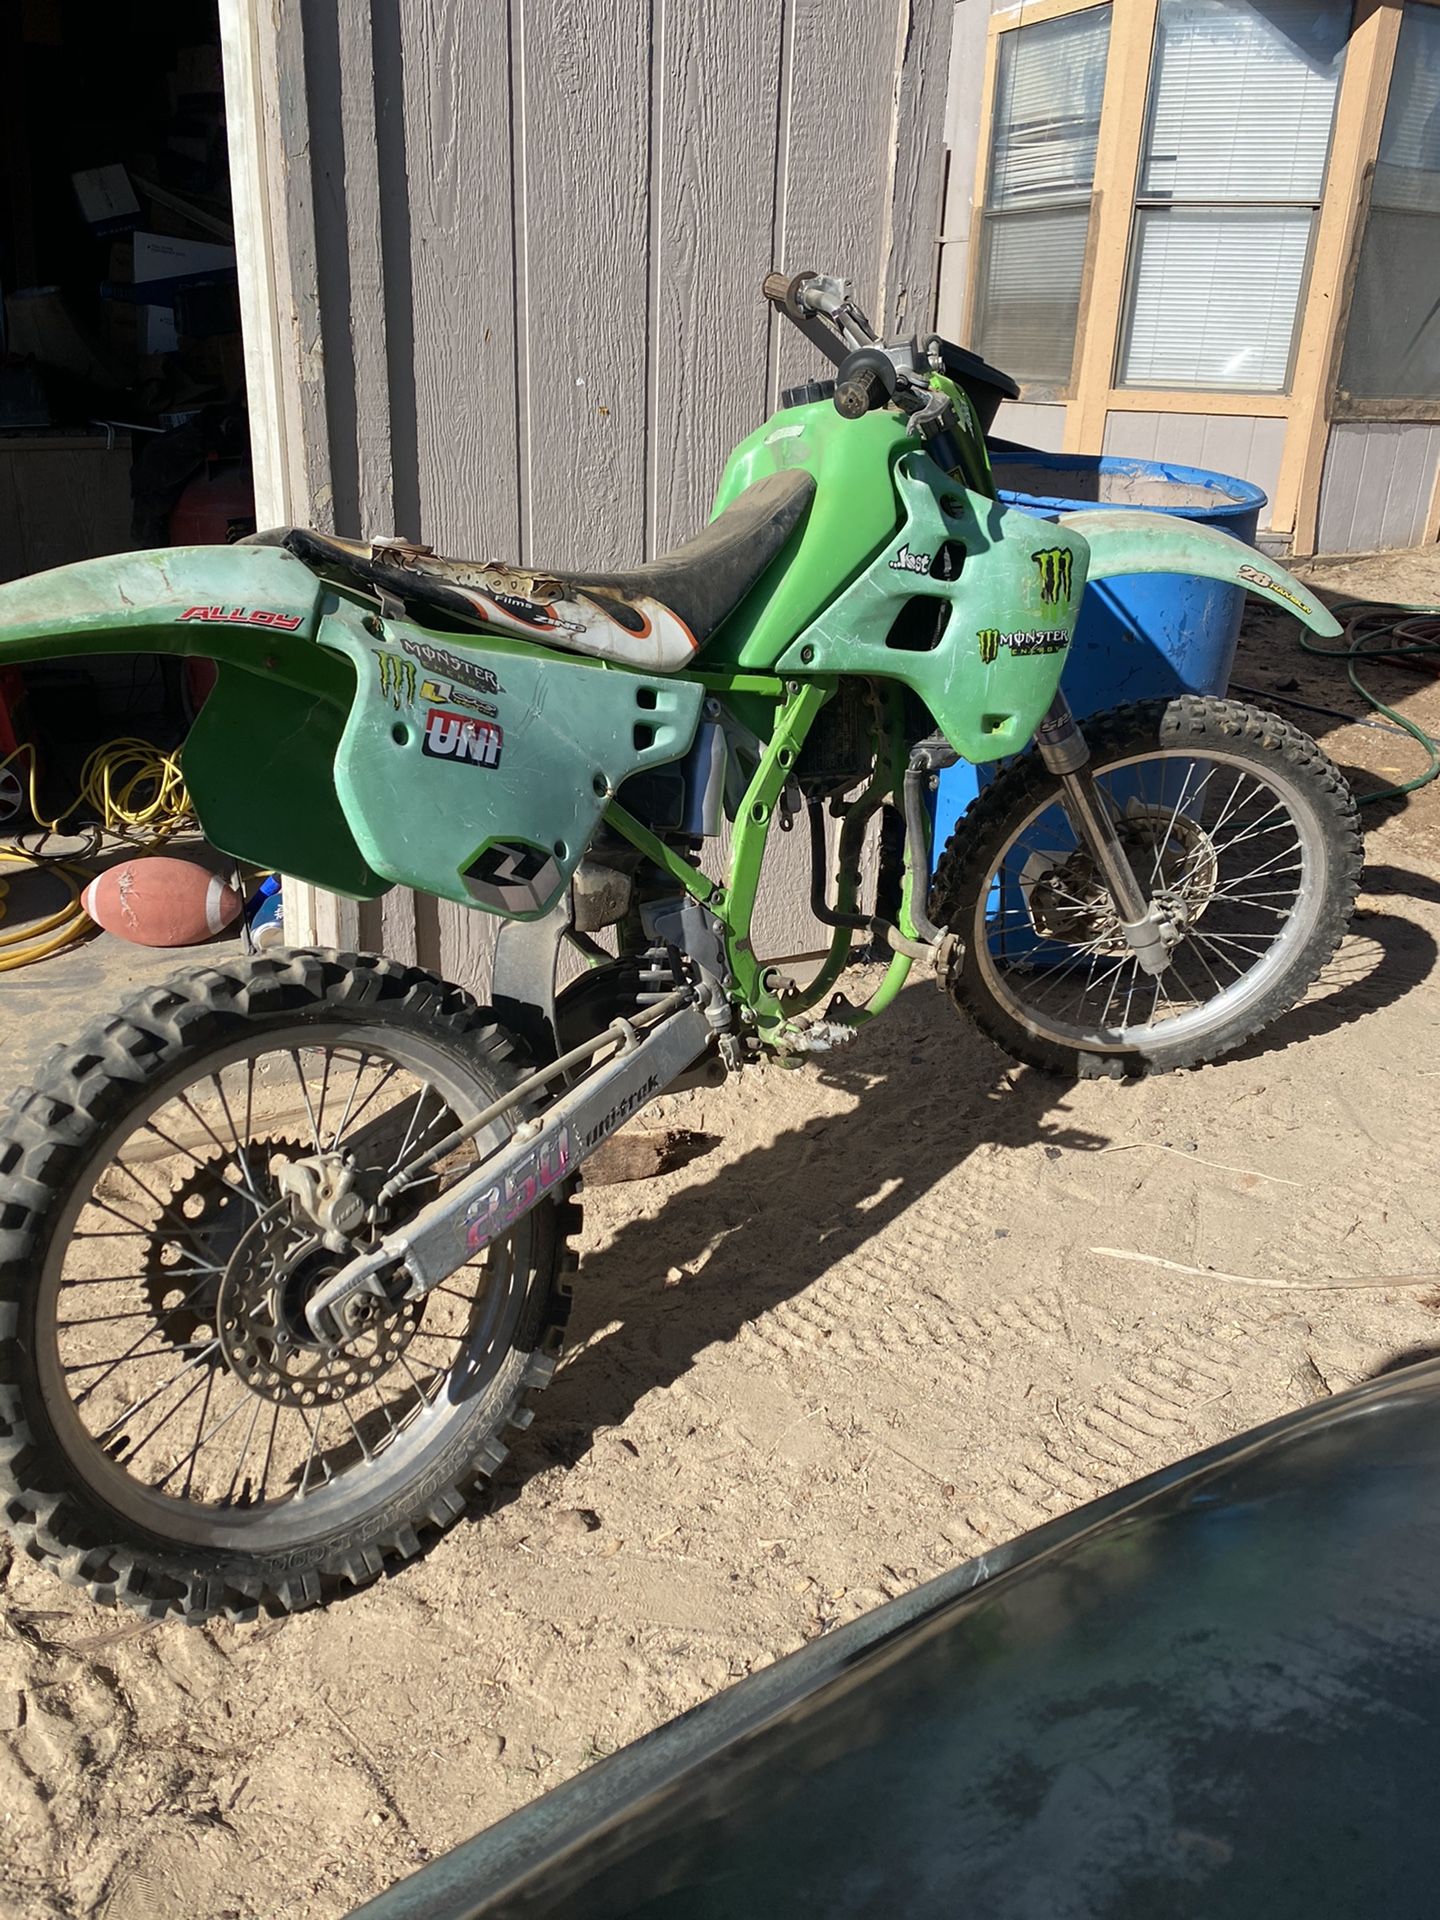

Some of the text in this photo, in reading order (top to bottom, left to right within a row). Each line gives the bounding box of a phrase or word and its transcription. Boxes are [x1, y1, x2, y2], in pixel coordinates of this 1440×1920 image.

[175, 605, 304, 631] ALLOY
[494, 594, 533, 610] Films
[1000, 629, 1068, 647] MONSTER
[402, 639, 501, 689] MONSTER
[427, 715, 500, 765] UNI
[463, 1125, 569, 1253] 250
